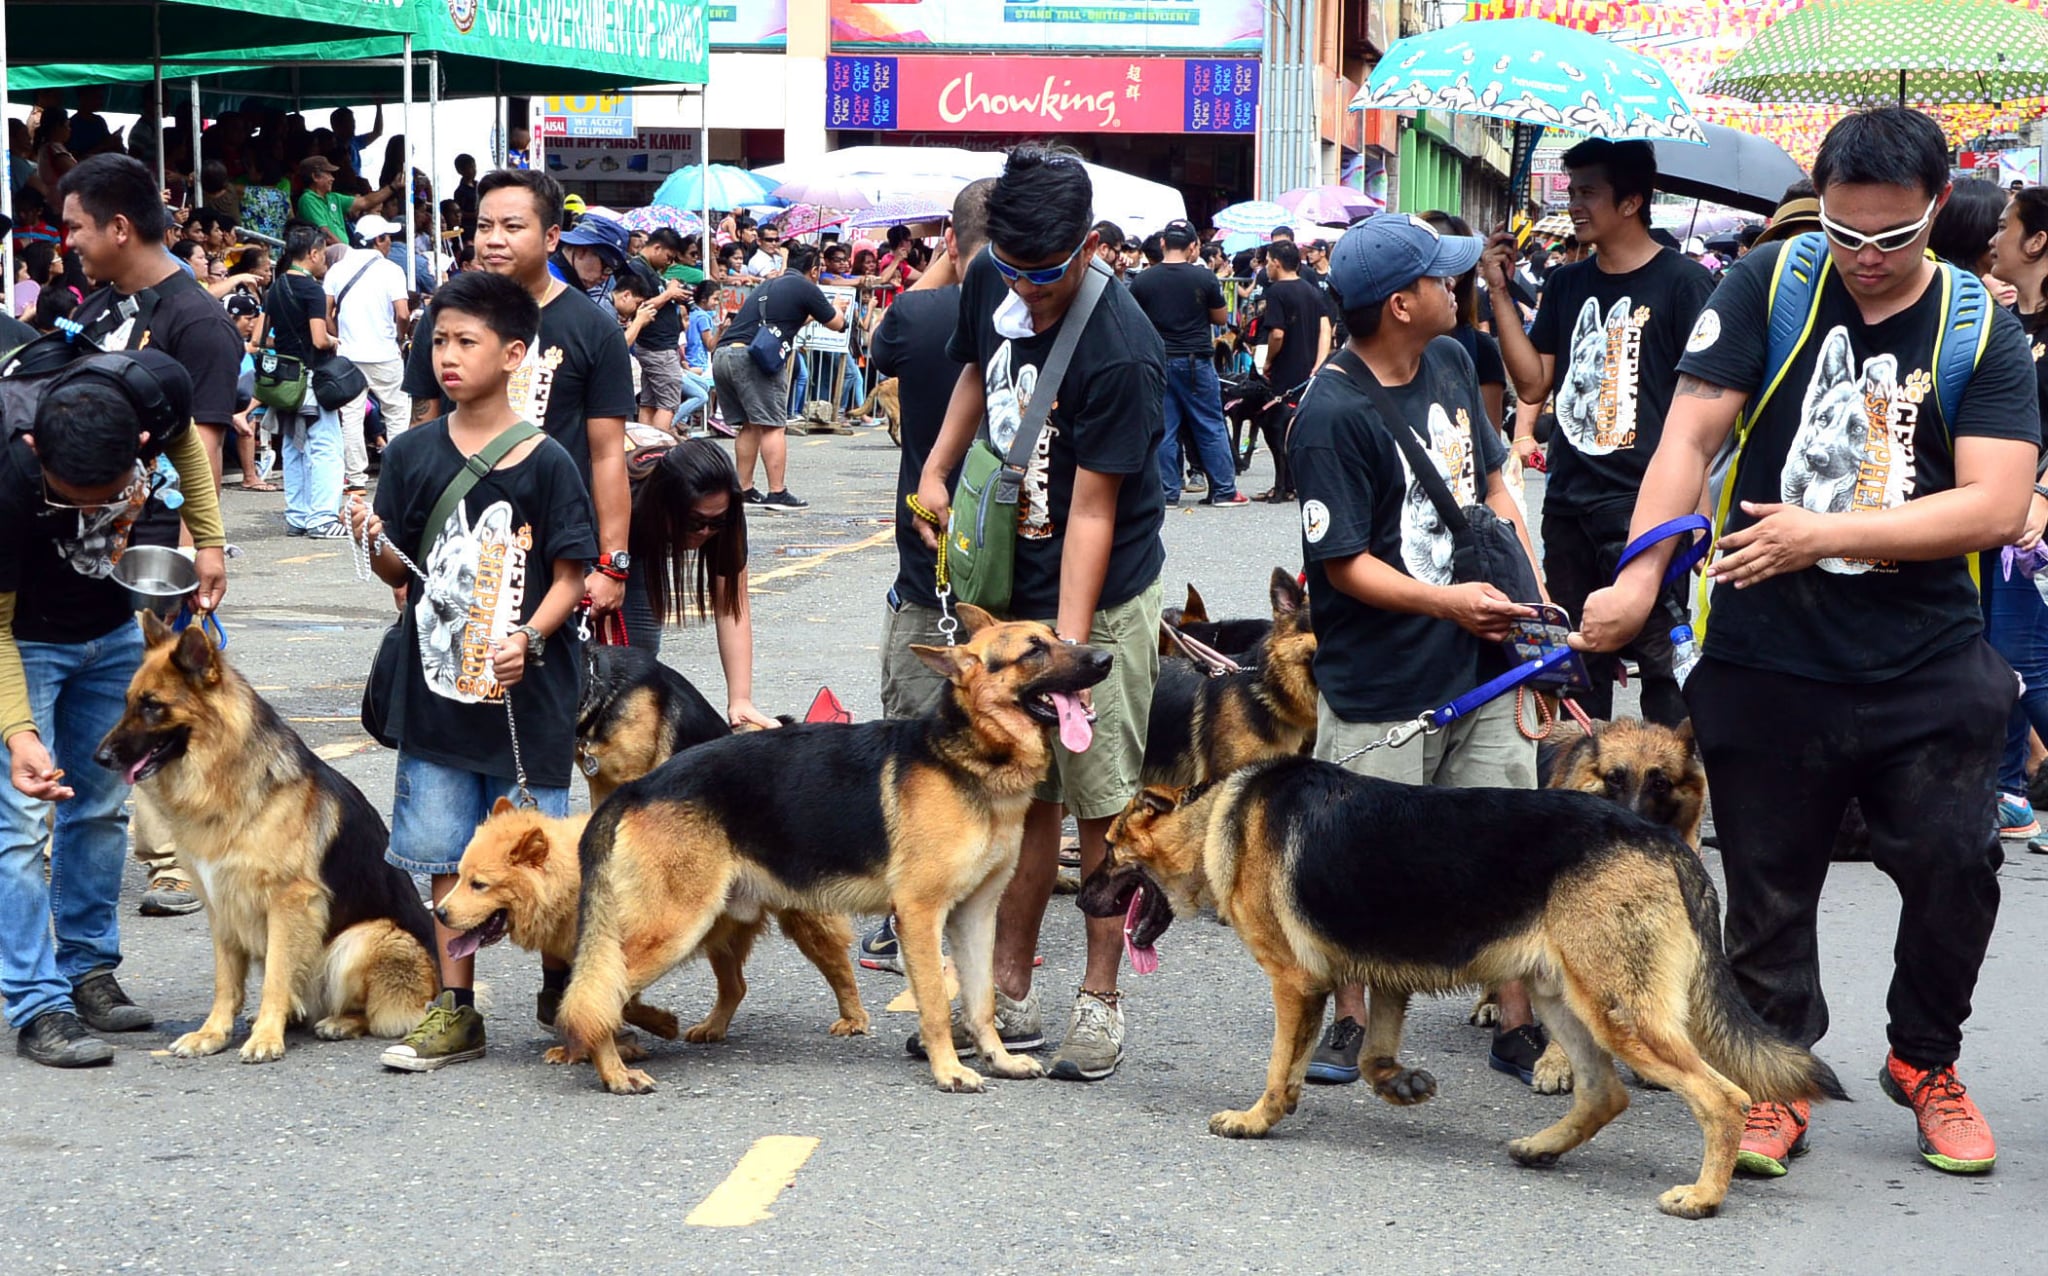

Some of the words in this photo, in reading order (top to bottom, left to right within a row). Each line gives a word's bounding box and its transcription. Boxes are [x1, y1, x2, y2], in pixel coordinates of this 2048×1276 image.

[526, 0, 634, 57] GOVERNMENT
[635, 0, 656, 59] OF
[657, 3, 704, 65] DAVAO
[592, 118, 623, 127] ACCEPT
[938, 71, 1116, 127] Chowking
[574, 127, 623, 136] CELLPHONE
[650, 134, 692, 150] KAMI!
[1597, 327, 1625, 433] SHEPHERD
[1595, 430, 1637, 448] GROUP
[1852, 393, 1893, 511] SHEPHE
[1888, 400, 1919, 497] GERM
[461, 541, 506, 677] SHEPHERD
